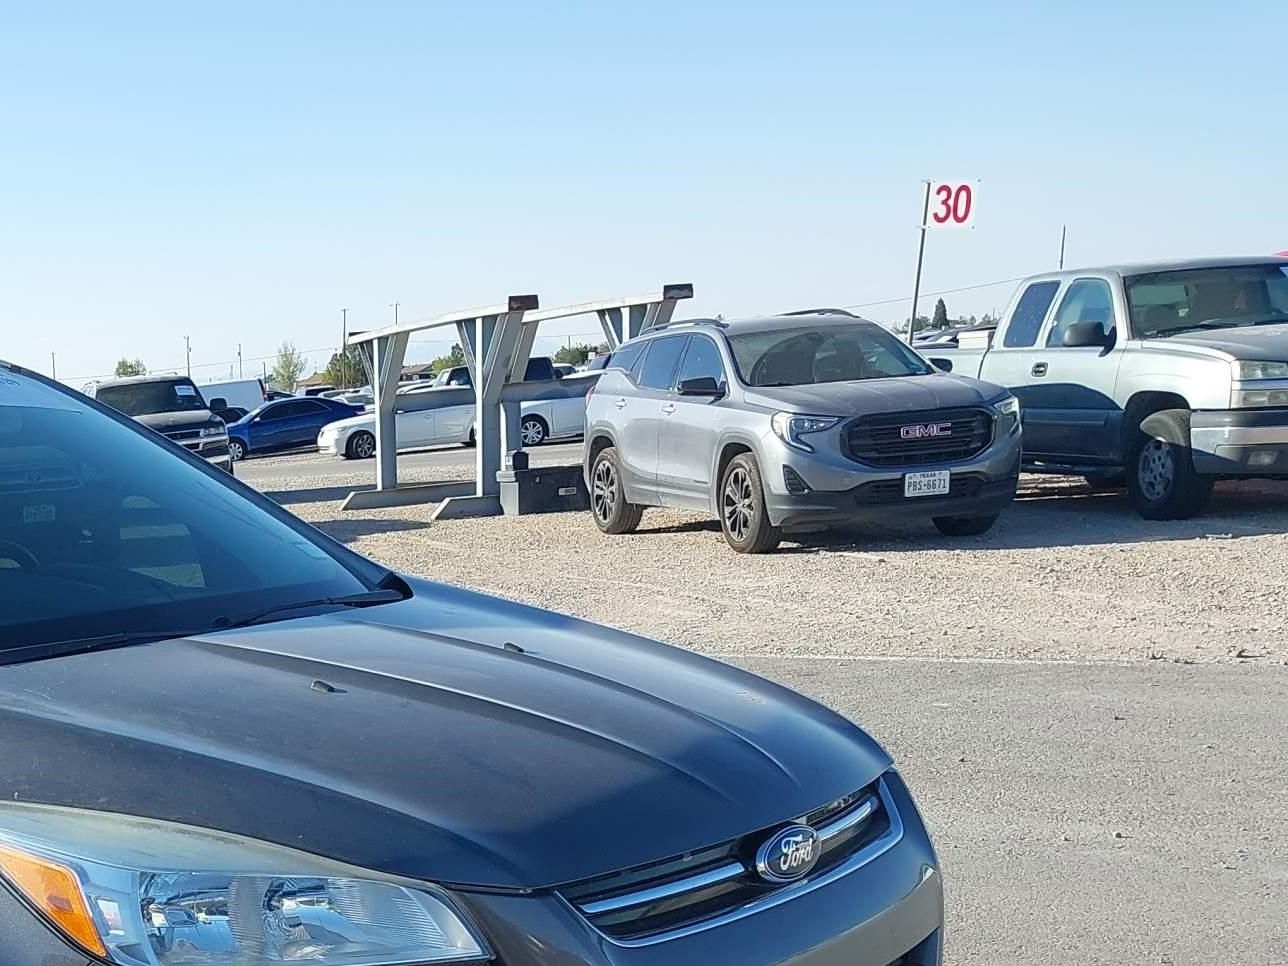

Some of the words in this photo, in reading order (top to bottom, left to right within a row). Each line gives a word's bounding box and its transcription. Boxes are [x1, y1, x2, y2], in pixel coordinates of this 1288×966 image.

[933, 185, 971, 223] 30
[900, 423, 951, 438] GMC
[780, 834, 814, 871] Ford
